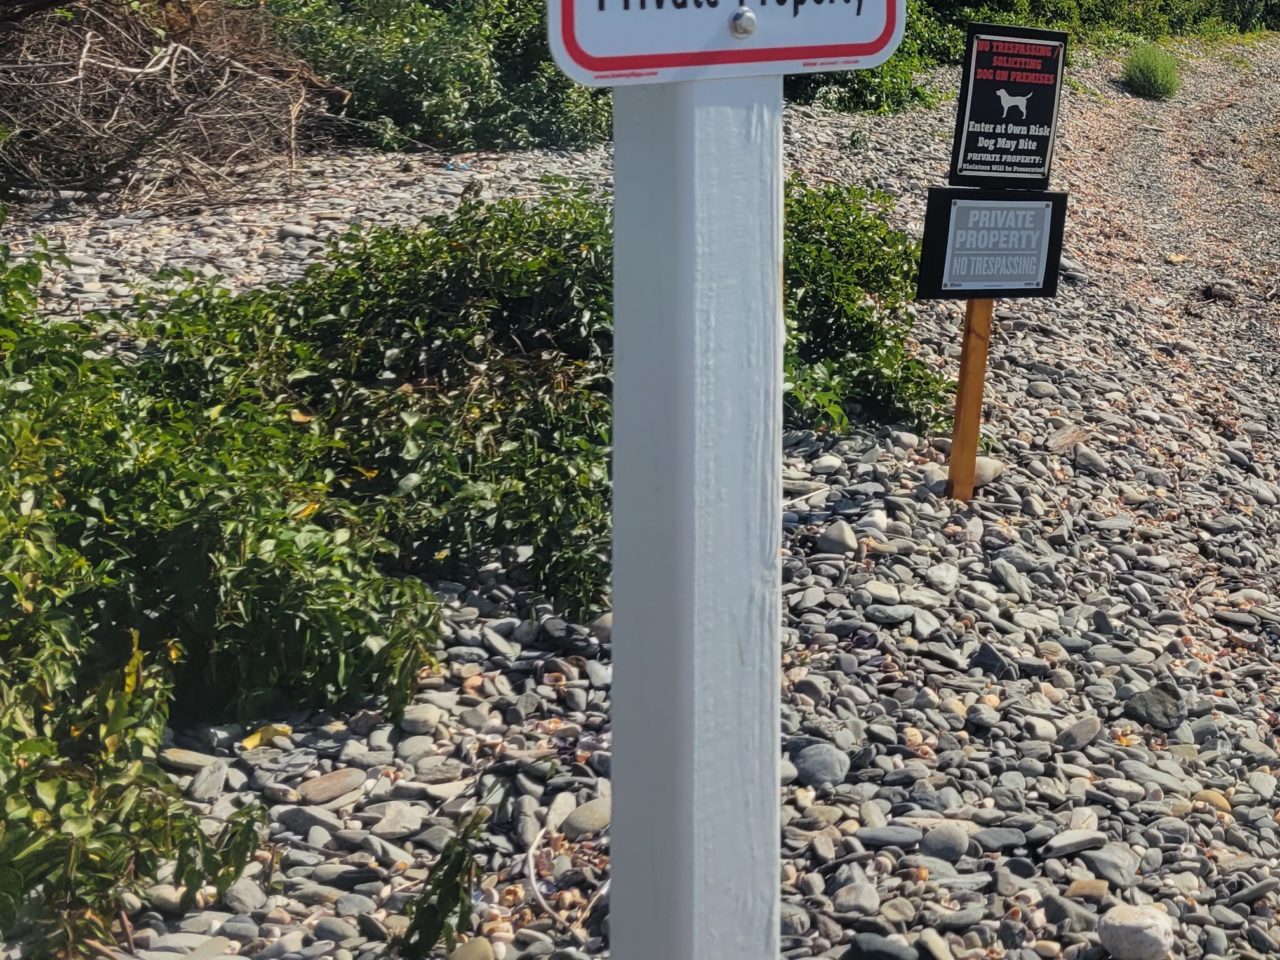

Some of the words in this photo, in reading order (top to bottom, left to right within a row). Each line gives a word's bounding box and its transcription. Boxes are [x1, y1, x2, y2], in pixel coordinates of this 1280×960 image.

[977, 41, 990, 52] NO
[992, 42, 1052, 57] TRESPASSING
[992, 56, 1042, 70] SOLICITING
[976, 69, 994, 80] DOG
[995, 71, 1009, 81] ON
[1010, 71, 1055, 85] PREMISES
[968, 121, 994, 133] Enter
[995, 123, 1006, 134] at
[1007, 123, 1027, 135] Own
[1028, 124, 1050, 136] Risk
[977, 136, 995, 150] Dog
[996, 137, 1017, 151] May
[1018, 138, 1037, 150] Bite
[967, 152, 1000, 162] PRIVATE
[968, 210, 1036, 228] PRIVATE
[955, 230, 1041, 249] PROPERTY
[952, 256, 968, 276] NO
[970, 256, 1037, 276] TRESPASSING
